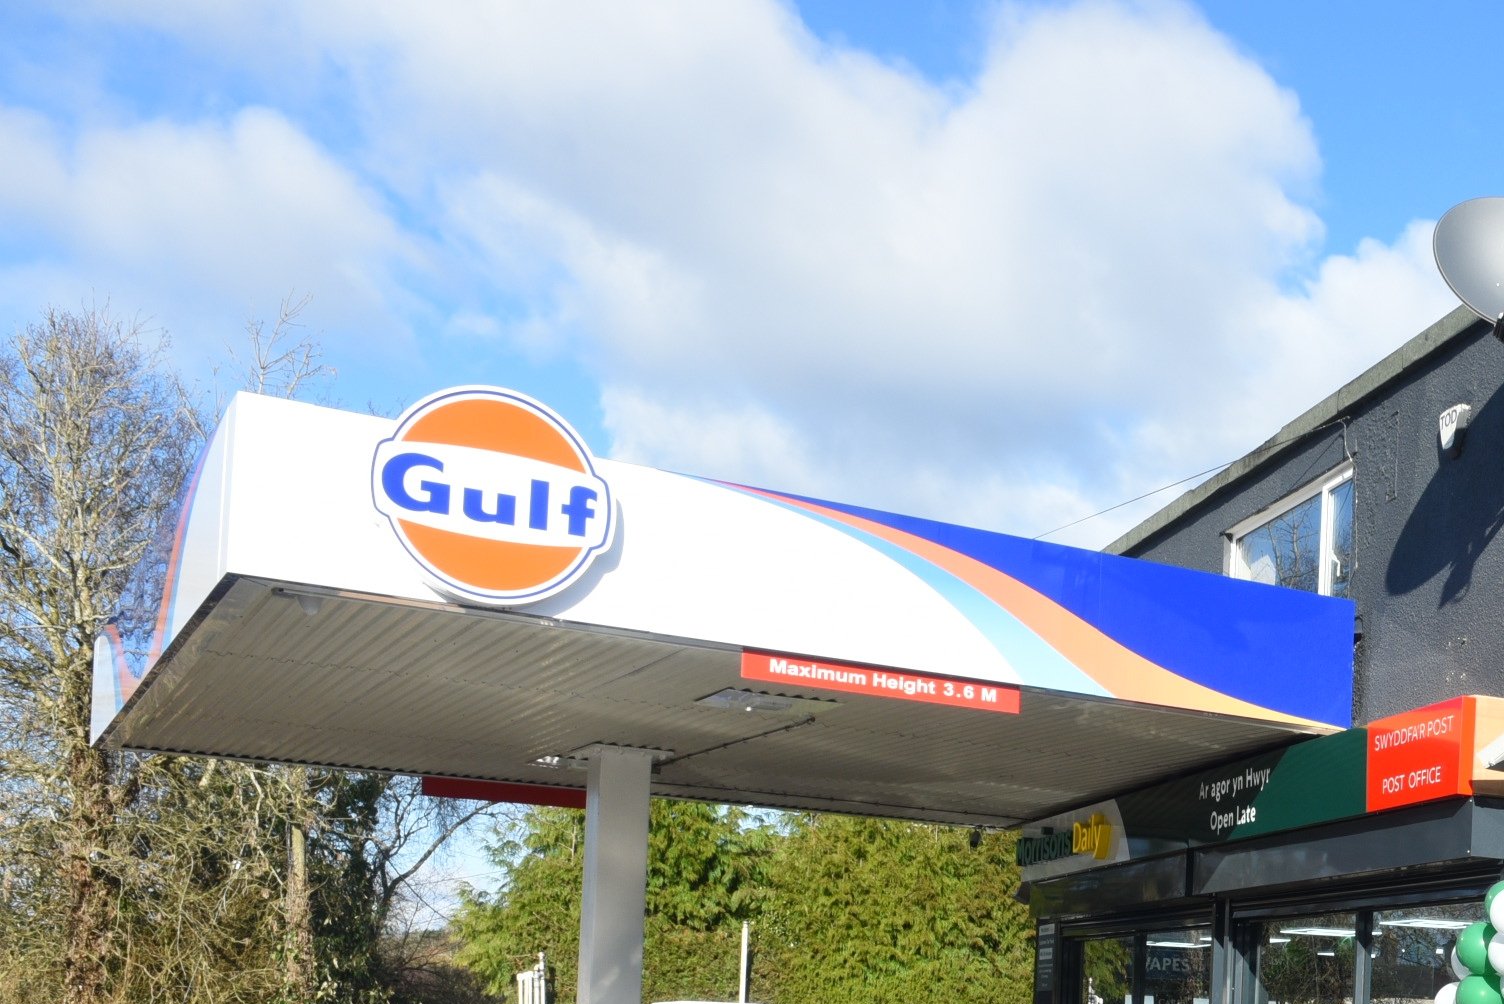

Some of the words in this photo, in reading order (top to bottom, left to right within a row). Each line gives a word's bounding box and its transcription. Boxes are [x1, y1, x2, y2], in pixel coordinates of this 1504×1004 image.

[381, 452, 598, 537] Gulf
[769, 658, 866, 685] Maximum
[872, 672, 936, 695] Height
[943, 682, 975, 699] 3.6
[981, 687, 997, 702] M
[1427, 714, 1454, 737] POST
[1199, 781, 1209, 800] Ar
[1210, 778, 1230, 802] agor
[1232, 775, 1243, 798] yn
[1245, 767, 1271, 791] Hwyr
[1382, 774, 1405, 795] POST
[1408, 766, 1441, 789] OFFICE
[1210, 811, 1234, 835] Open
[1236, 804, 1256, 825] Late
[1016, 829, 1073, 867] Morrisons
[1073, 819, 1101, 860] Daily
